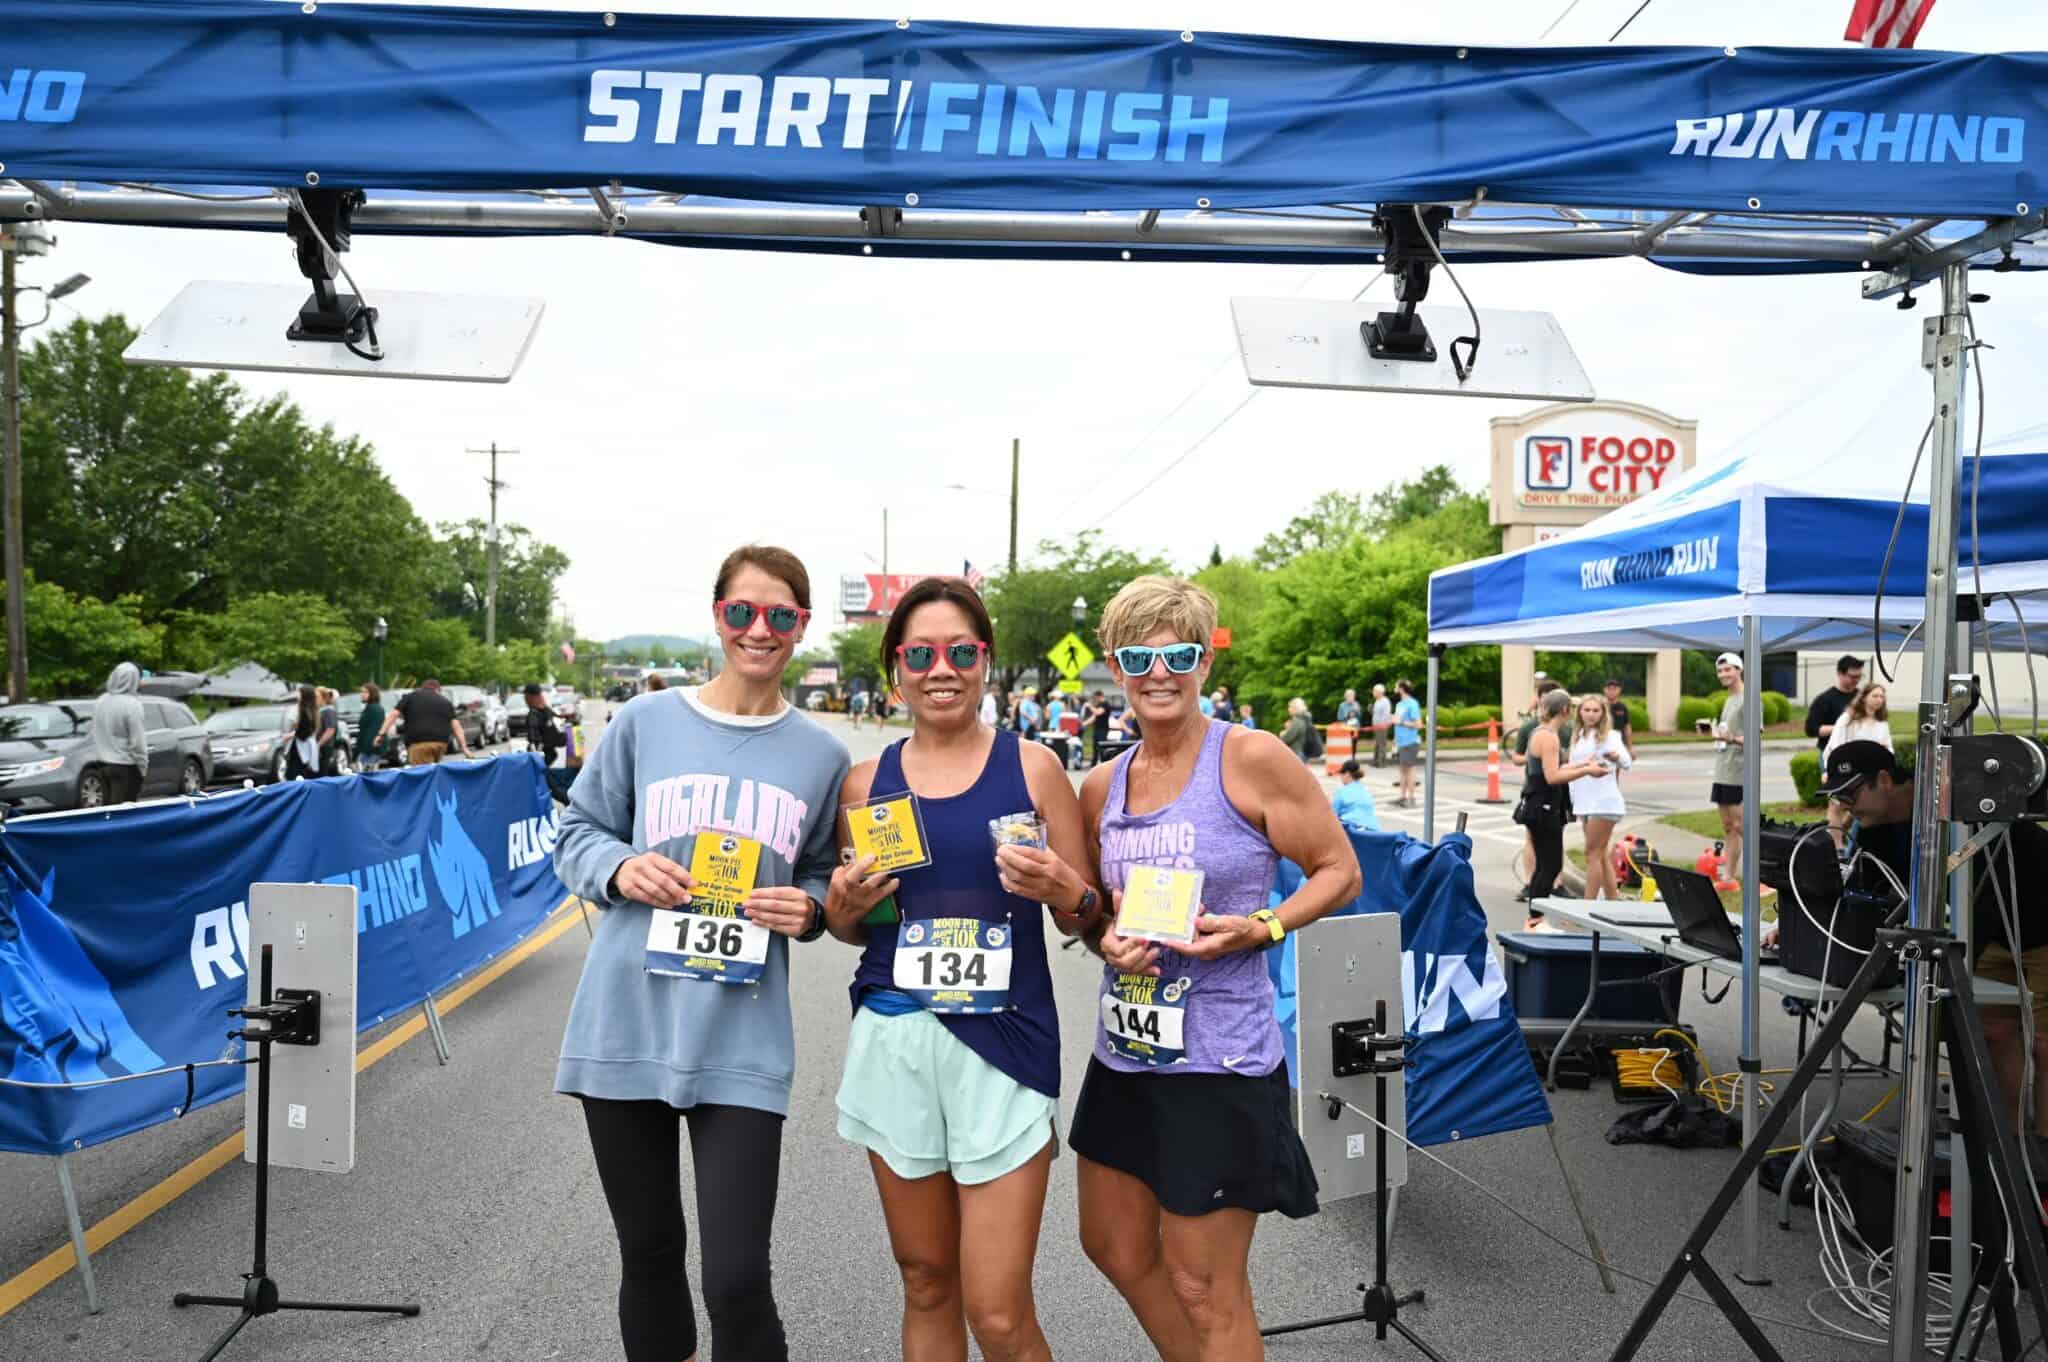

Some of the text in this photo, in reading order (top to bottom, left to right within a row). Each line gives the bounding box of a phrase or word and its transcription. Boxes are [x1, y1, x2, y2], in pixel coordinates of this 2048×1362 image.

[584, 69, 1231, 162] START/FINISH
[1669, 108, 2026, 163] RUNRHINO
[1580, 436, 1676, 465] FOOD
[1588, 465, 1667, 493] CITY
[1524, 494, 1560, 505] DRIVE
[1567, 495, 1599, 505] THRU
[644, 773, 808, 865] HIGHLANDS
[885, 831, 903, 847] 10K
[1103, 821, 1195, 863] RUNNING
[721, 865, 739, 881] 10K
[710, 883, 722, 891] Age
[724, 884, 743, 894] Group
[712, 897, 737, 920] 10K
[933, 918, 980, 930] MOON PIE
[673, 917, 744, 957] 136
[953, 928, 979, 948] 10K
[917, 951, 987, 987] 134
[1119, 974, 1159, 987] MOON PIE
[1132, 986, 1156, 1005] 10K
[1112, 1003, 1161, 1043] 144
